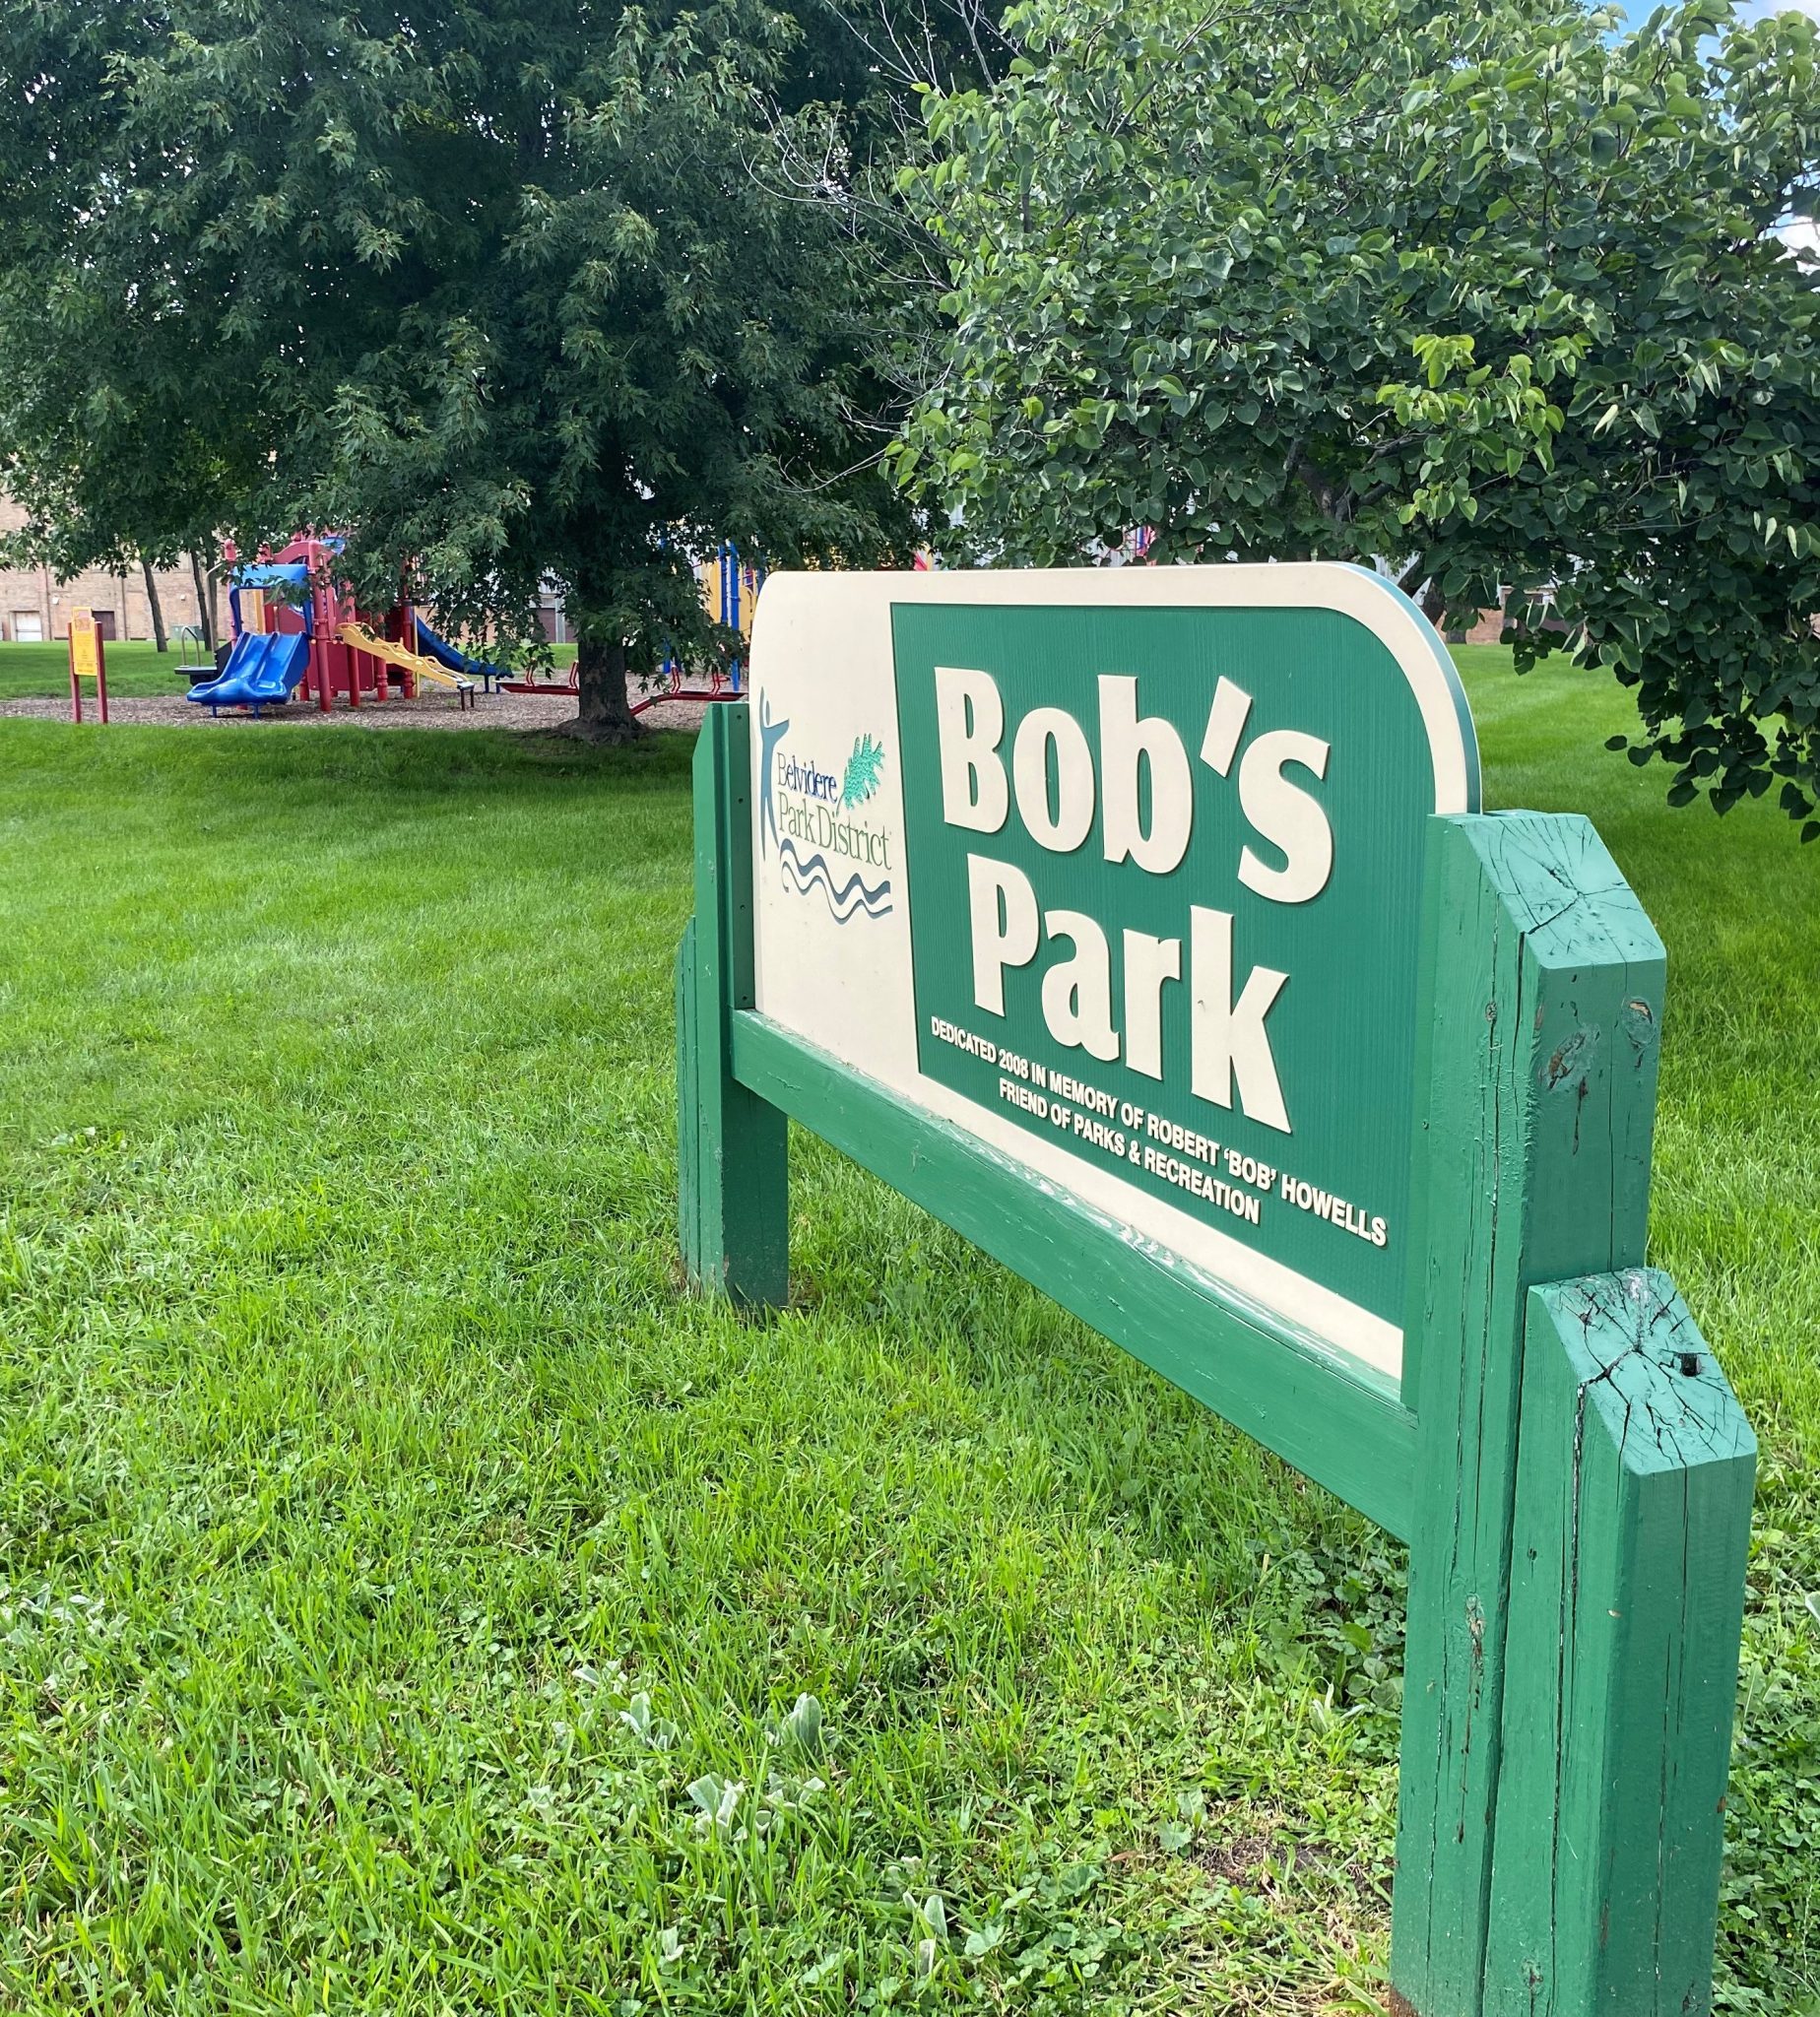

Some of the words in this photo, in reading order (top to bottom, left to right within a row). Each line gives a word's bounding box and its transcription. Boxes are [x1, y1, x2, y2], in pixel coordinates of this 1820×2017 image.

[776, 751, 838, 803] Belvidere
[778, 792, 816, 844] Park
[816, 805, 891, 871] District
[934, 666, 1334, 903] Bob's
[966, 852, 1291, 1135] Park
[931, 1015, 998, 1064] DEDICATED
[998, 1048, 1029, 1079] 2008
[1031, 1062, 1047, 1088] IN
[1049, 1070, 1119, 1119] MEMORY
[1120, 1102, 1144, 1131] OF
[1146, 1112, 1220, 1166] ROBERT
[1280, 1173, 1387, 1247] HOWELLS
[999, 1076, 1048, 1119] FRIEND
[1050, 1103, 1072, 1130] OF
[1073, 1113, 1126, 1157] PARKS
[1128, 1139, 1141, 1166] &
[1143, 1145, 1261, 1225] RECREATION
